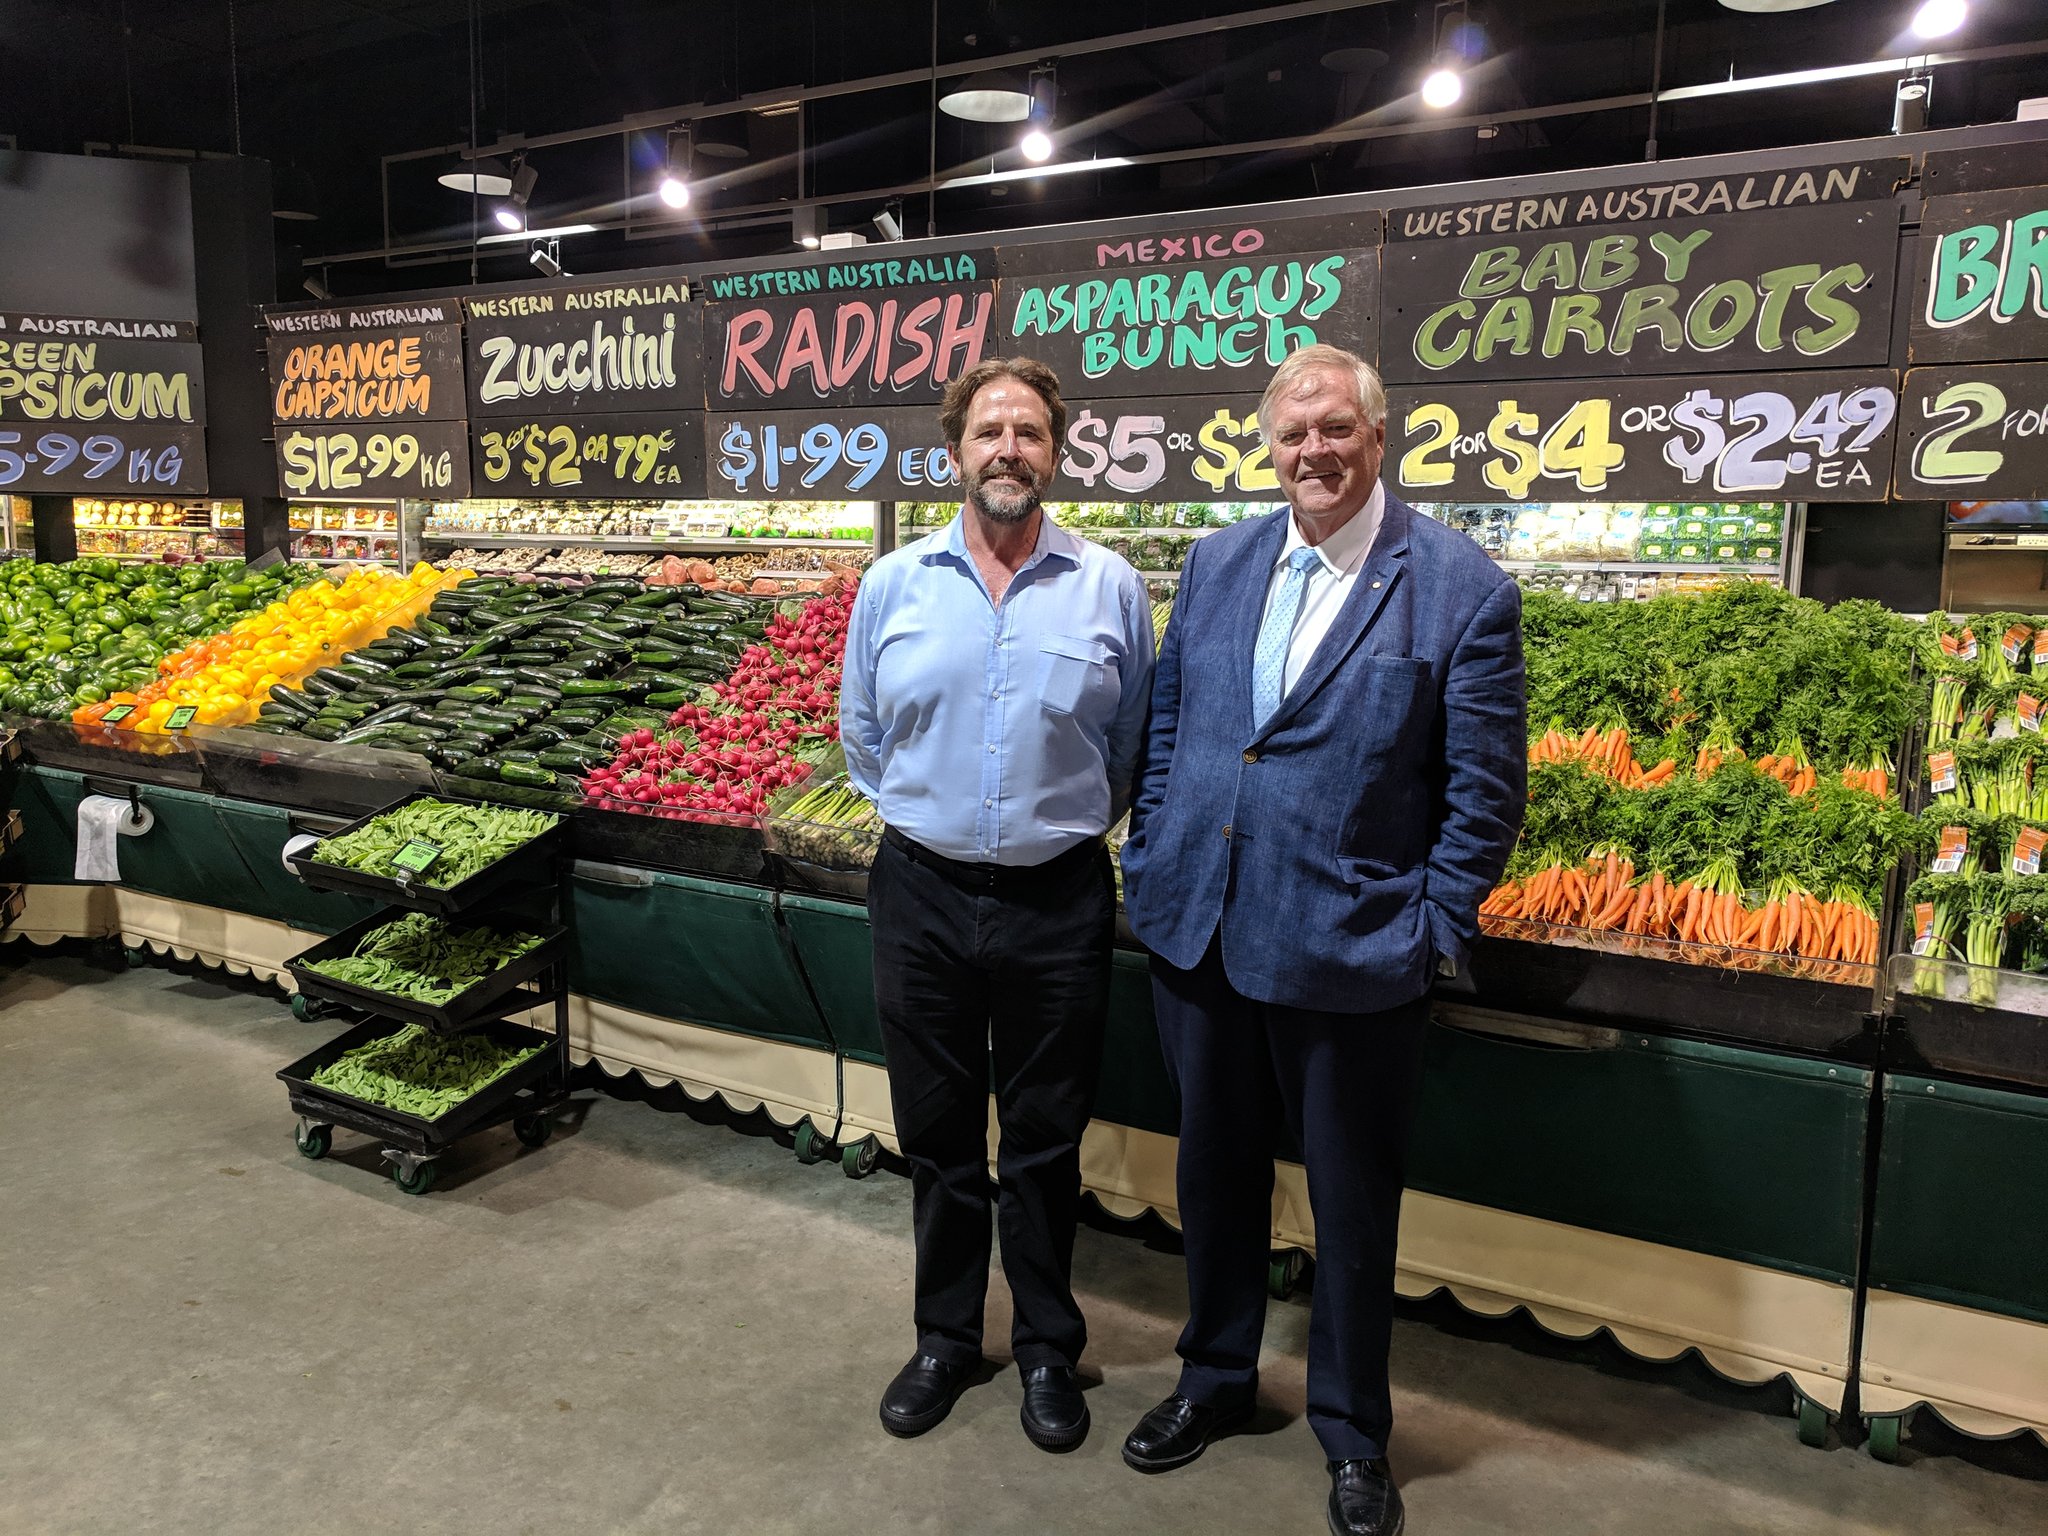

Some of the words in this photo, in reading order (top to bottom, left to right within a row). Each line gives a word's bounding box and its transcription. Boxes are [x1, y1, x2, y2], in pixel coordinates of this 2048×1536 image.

[1404, 197, 1570, 238] WESTERN
[1575, 166, 1860, 222] AUSTRALIAN
[712, 268, 821, 298] WESTERN
[828, 254, 977, 289] AUSTRALIA
[1097, 229, 1264, 267] MEXICO
[1460, 229, 1712, 299] BABY
[271, 313, 342, 332] WESTERN
[349, 307, 444, 328] AUSTRALIAN
[470, 296, 554, 318] WESTERN
[565, 284, 690, 311] AUSTRALIAN
[1012, 255, 1345, 337] ASPARAGUS
[1413, 263, 1873, 370] CARROTS
[19, 317, 178, 338] AUSTRALIAN
[719, 293, 993, 398] RADISH
[285, 336, 422, 381] ORANGE
[480, 312, 676, 404] Zucchini
[276, 374, 431, 420] CAPSICUM
[481, 431, 511, 482] 3
[717, 421, 888, 493] $1.99
[1061, 409, 1167, 493] $5
[1167, 433, 1194, 452] OR
[1399, 403, 1460, 487] 2
[1450, 432, 1487, 459] FOR
[1482, 399, 1626, 499] $4
[1620, 404, 1670, 433] OR
[1663, 386, 1896, 493] $2.49
[1911, 382, 2007, 484] 2
[128, 445, 183, 485] KG
[283, 431, 419, 495] $12.99
[420, 451, 452, 488] KG
[654, 465, 682, 484] EA
[1815, 459, 1872, 488] EA
